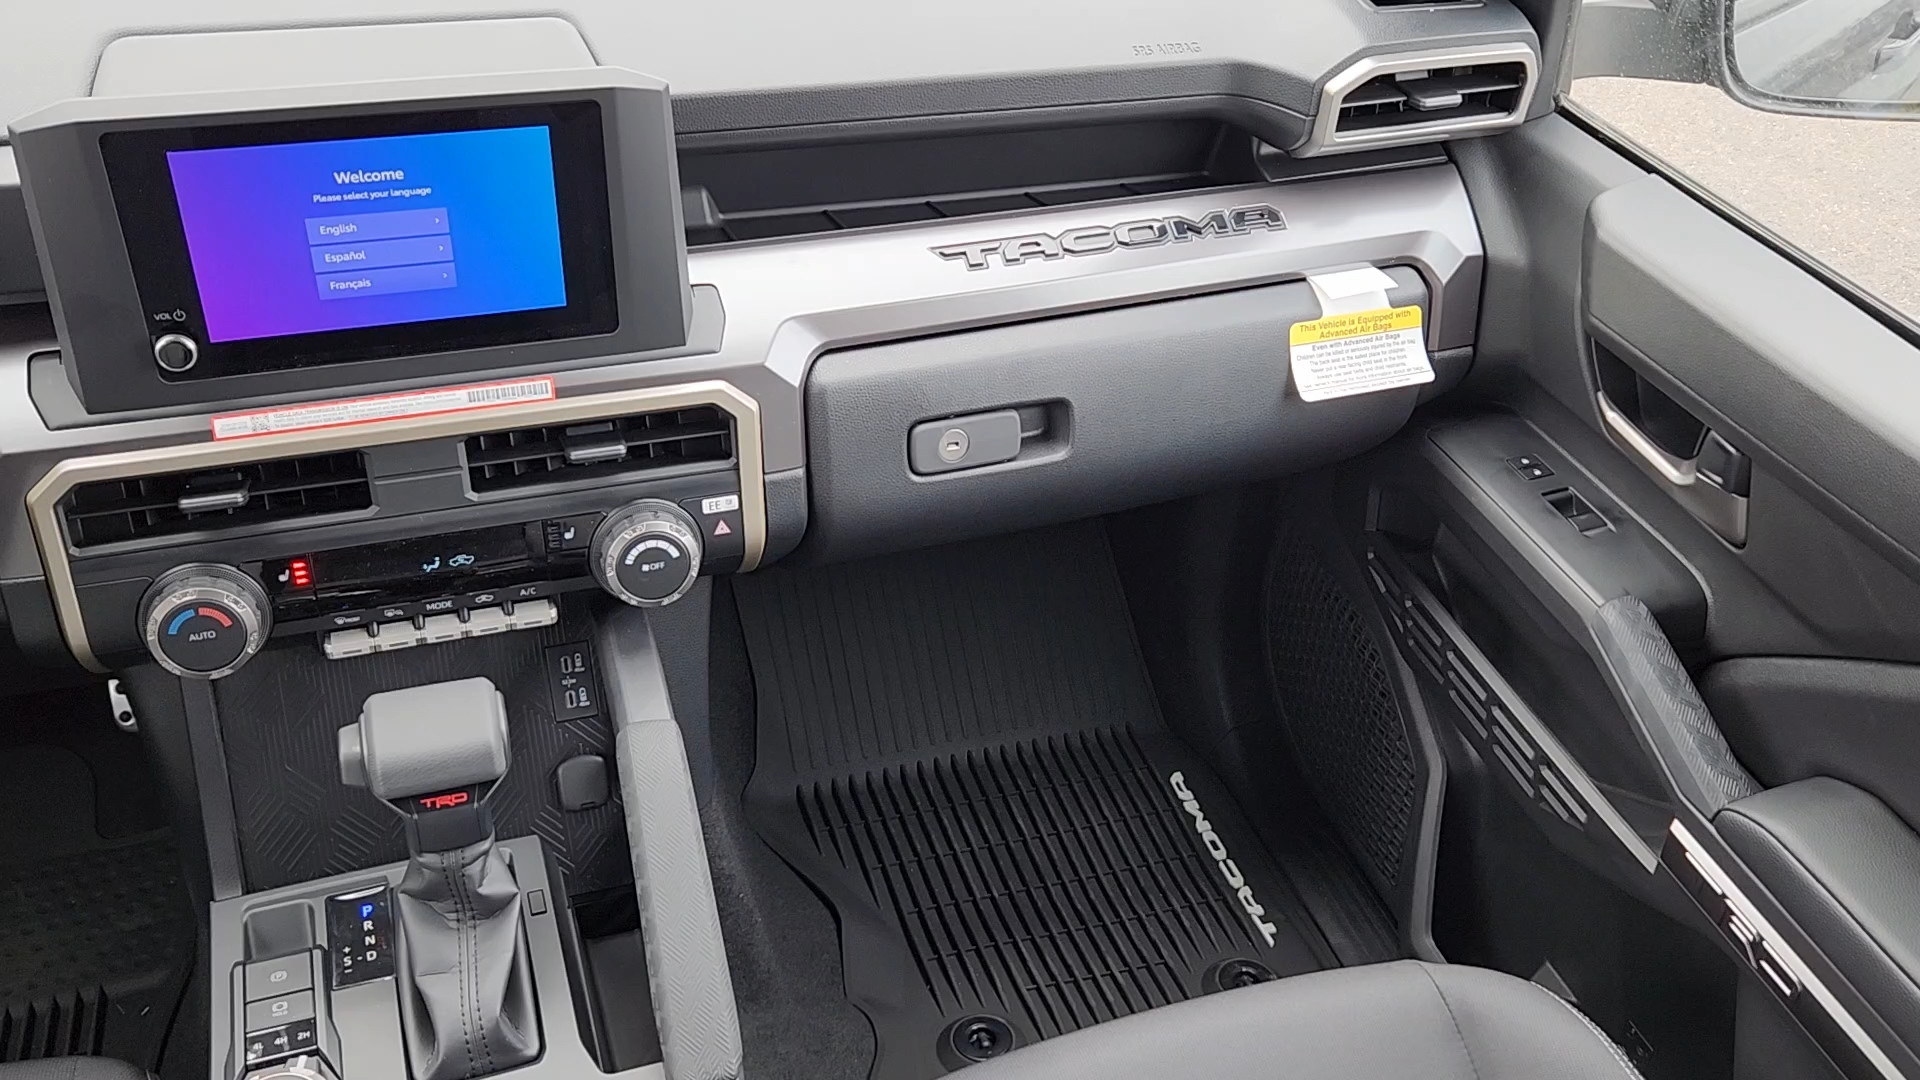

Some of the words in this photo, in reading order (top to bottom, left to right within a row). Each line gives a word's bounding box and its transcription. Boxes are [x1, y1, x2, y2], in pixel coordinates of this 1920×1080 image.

[1132, 44, 1154, 56] SRS
[1156, 41, 1201, 55] AIRBAG
[333, 169, 405, 184] Welcome
[313, 194, 341, 203] Please
[343, 191, 369, 201] select
[370, 190, 389, 200] your
[390, 187, 432, 198] language
[320, 222, 357, 236] English
[927, 202, 1289, 272] TACOMA
[324, 249, 367, 264] Español
[329, 277, 372, 291] Français
[153, 312, 173, 321] VOL
[1300, 324, 1316, 332] This
[1318, 319, 1347, 330] Vehicle
[1357, 312, 1394, 326] Equipped
[1396, 309, 1411, 318] with
[1319, 326, 1358, 339] Advanced
[1359, 324, 1371, 333] Air
[1373, 322, 1392, 332] Bags
[1312, 344, 1328, 352] Even
[1329, 341, 1343, 349] with
[1343, 337, 1374, 347] Advanced
[1385, 333, 1401, 341] Bags
[649, 561, 666, 571] OFF
[519, 587, 537, 597] A/C
[426, 600, 453, 611] MODE
[188, 630, 216, 643] AUTO
[420, 792, 469, 809] TRD
[1170, 771, 1278, 949] TACOMA
[362, 904, 373, 918] P
[363, 920, 375, 932] R
[364, 934, 376, 946] N
[343, 956, 353, 967] S
[366, 950, 378, 962] D
[273, 1035, 289, 1046] 4H
[297, 1030, 311, 1041] 2H
